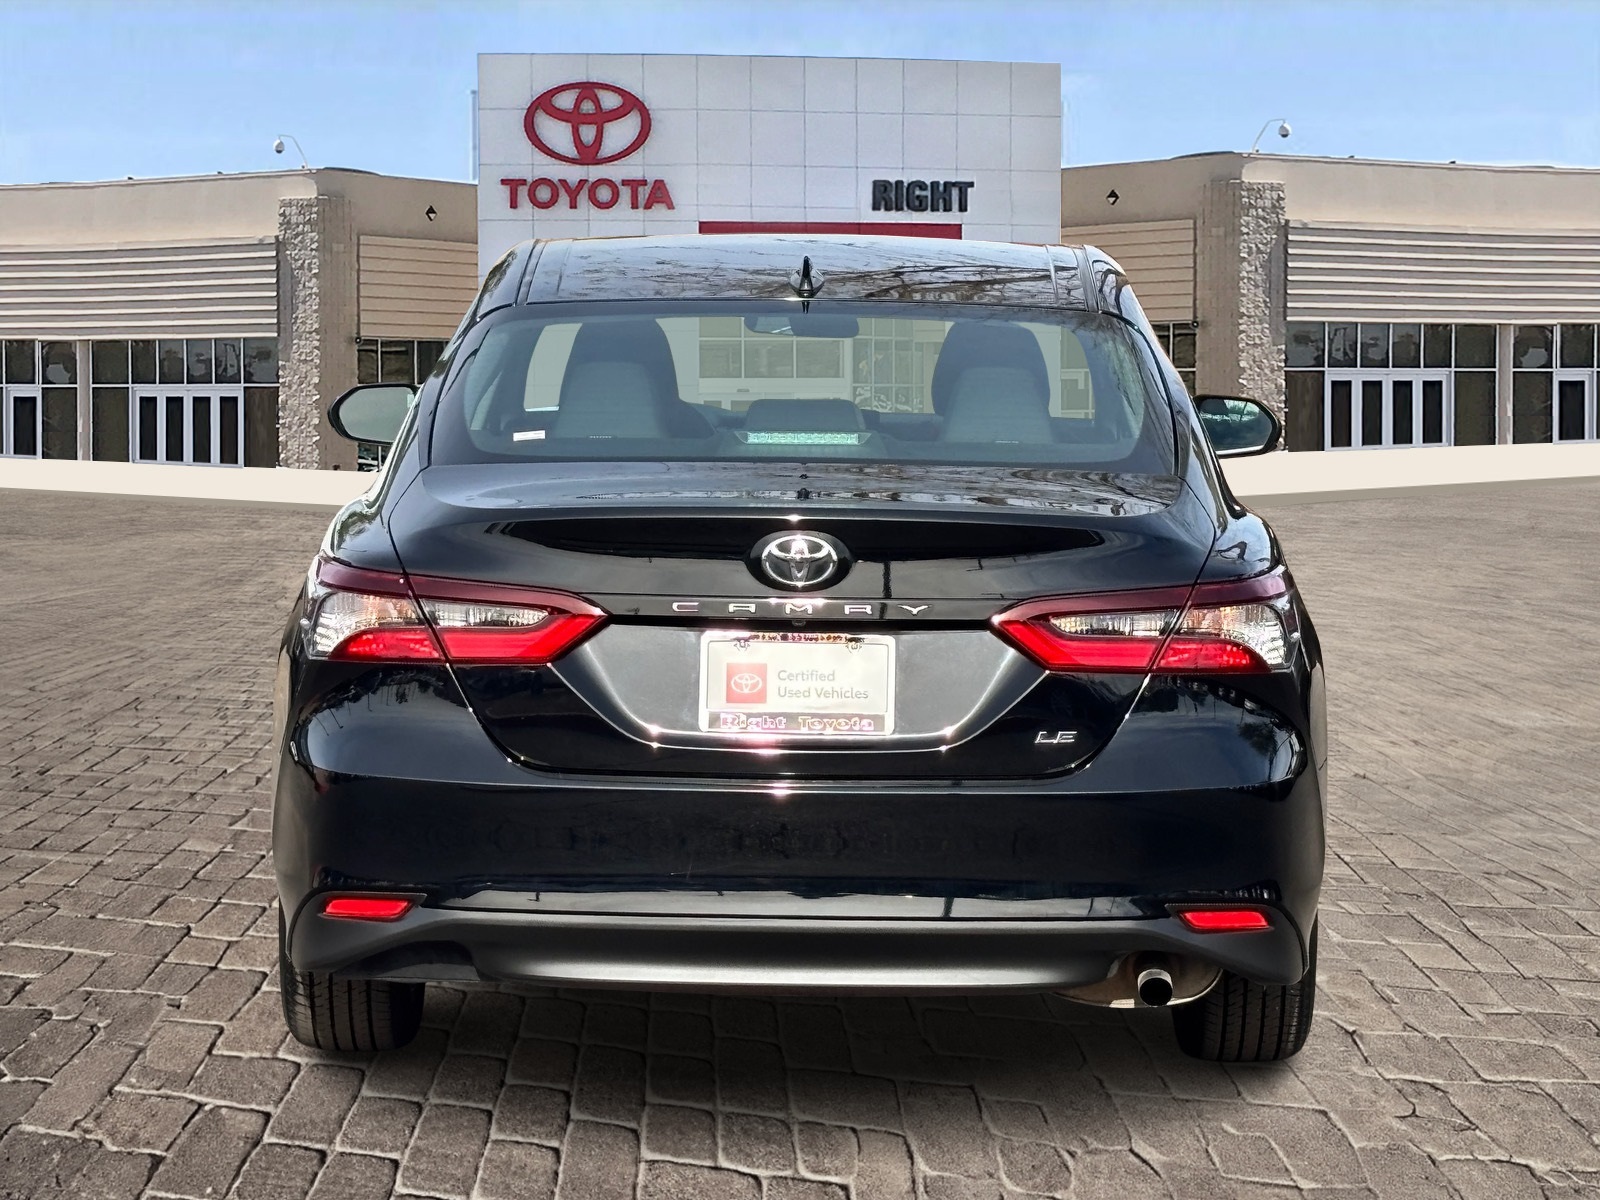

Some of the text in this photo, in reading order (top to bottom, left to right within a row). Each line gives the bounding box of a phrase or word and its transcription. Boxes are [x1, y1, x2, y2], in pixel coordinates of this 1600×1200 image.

[501, 178, 675, 210] TOYOTA
[871, 180, 975, 212] RIGHT
[671, 601, 932, 615] CAMRY
[777, 669, 836, 682] Certified
[777, 686, 869, 699] Used Vehicles
[719, 712, 875, 731] Right Toyota
[1034, 731, 1078, 744] LE
